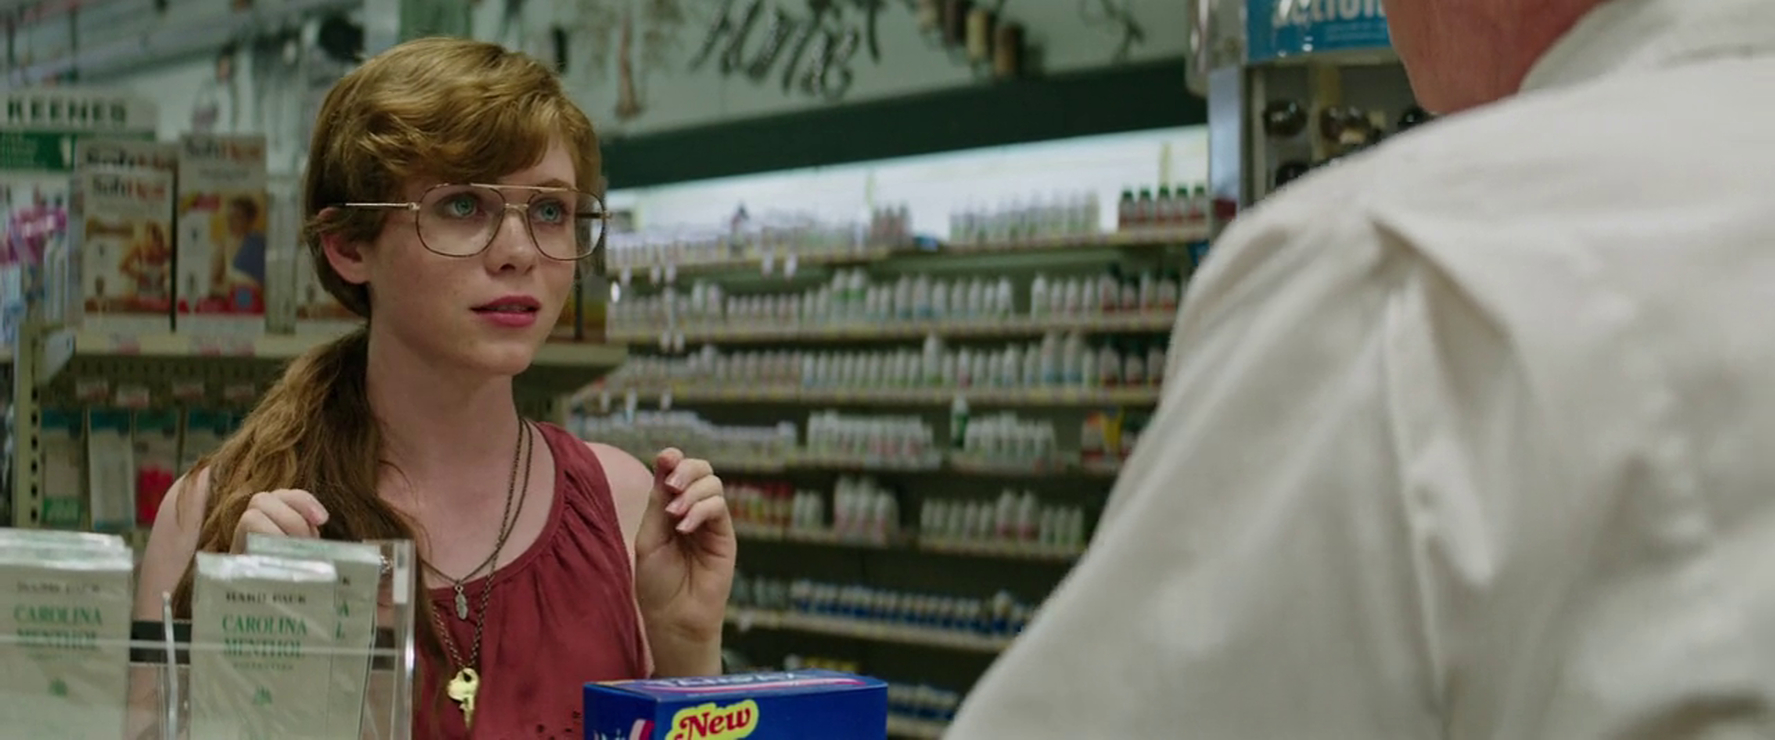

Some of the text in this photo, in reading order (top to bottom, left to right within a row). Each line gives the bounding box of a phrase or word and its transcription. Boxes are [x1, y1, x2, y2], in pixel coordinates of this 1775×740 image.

[13, 603, 103, 625] CAROLINA
[222, 615, 308, 636] CAROLINA
[16, 628, 98, 649] MENTHOL
[224, 638, 305, 658] MENTHOL
[673, 706, 752, 740] New
